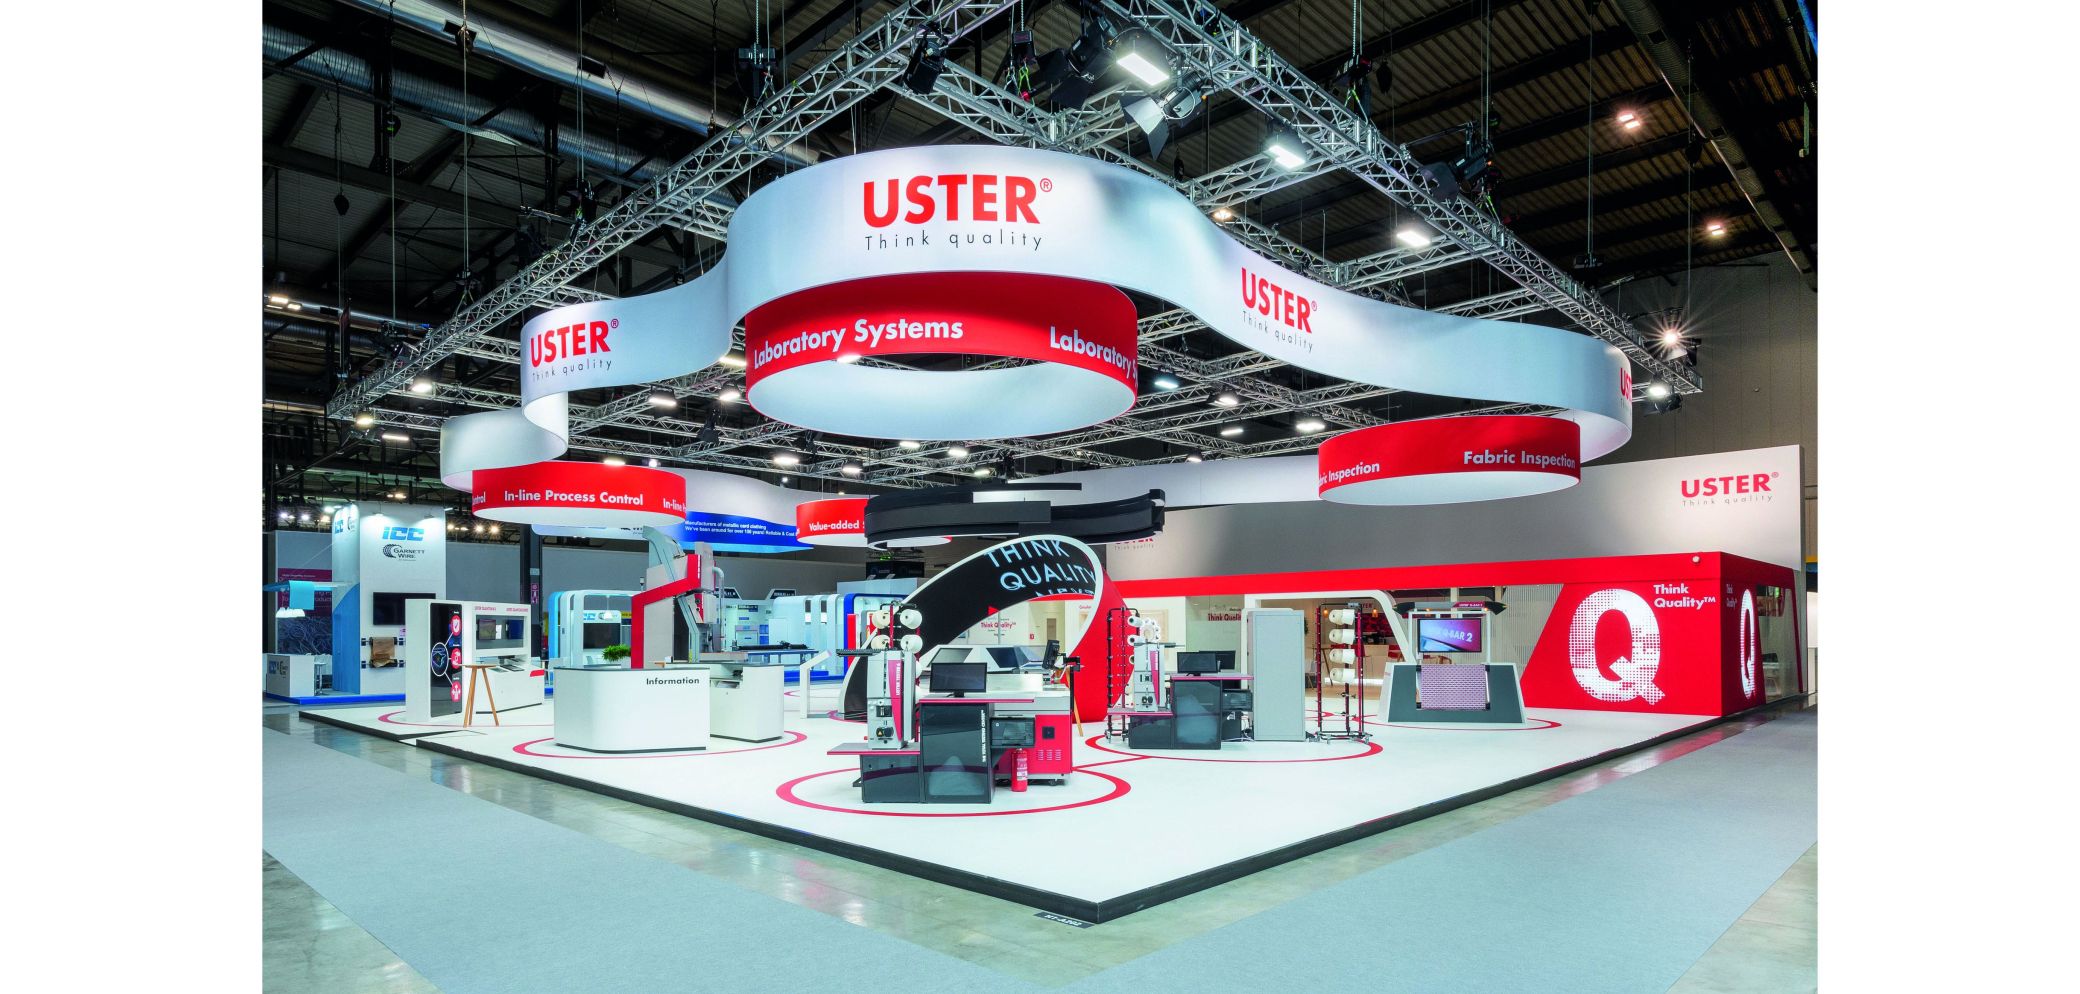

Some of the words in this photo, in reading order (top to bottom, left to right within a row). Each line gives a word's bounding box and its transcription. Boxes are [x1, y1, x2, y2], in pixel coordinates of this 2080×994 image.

[865, 230, 930, 251] Think
[949, 229, 1043, 251] quality
[1242, 310, 1268, 333] Think
[1274, 329, 1313, 353] quality
[753, 326, 847, 370] Laboratory
[853, 318, 964, 349] Systems
[1049, 325, 1132, 379] Laboratory
[532, 369, 556, 382] Think
[562, 359, 612, 376] quality
[1463, 449, 1516, 465] Fabric
[1520, 450, 1576, 470] Inspection
[1328, 461, 1381, 483] Inspection
[504, 488, 541, 502] In-line
[545, 489, 596, 503] Process
[599, 491, 644, 506] Control
[662, 497, 683, 512] In-line
[1682, 499, 1716, 507] Think
[1724, 494, 1774, 506] quality
[808, 519, 860, 532] Value-added
[983, 539, 1071, 568] THINK
[1653, 583, 1689, 595] Think
[1568, 588, 1666, 706] Q
[645, 677, 700, 687] Information
